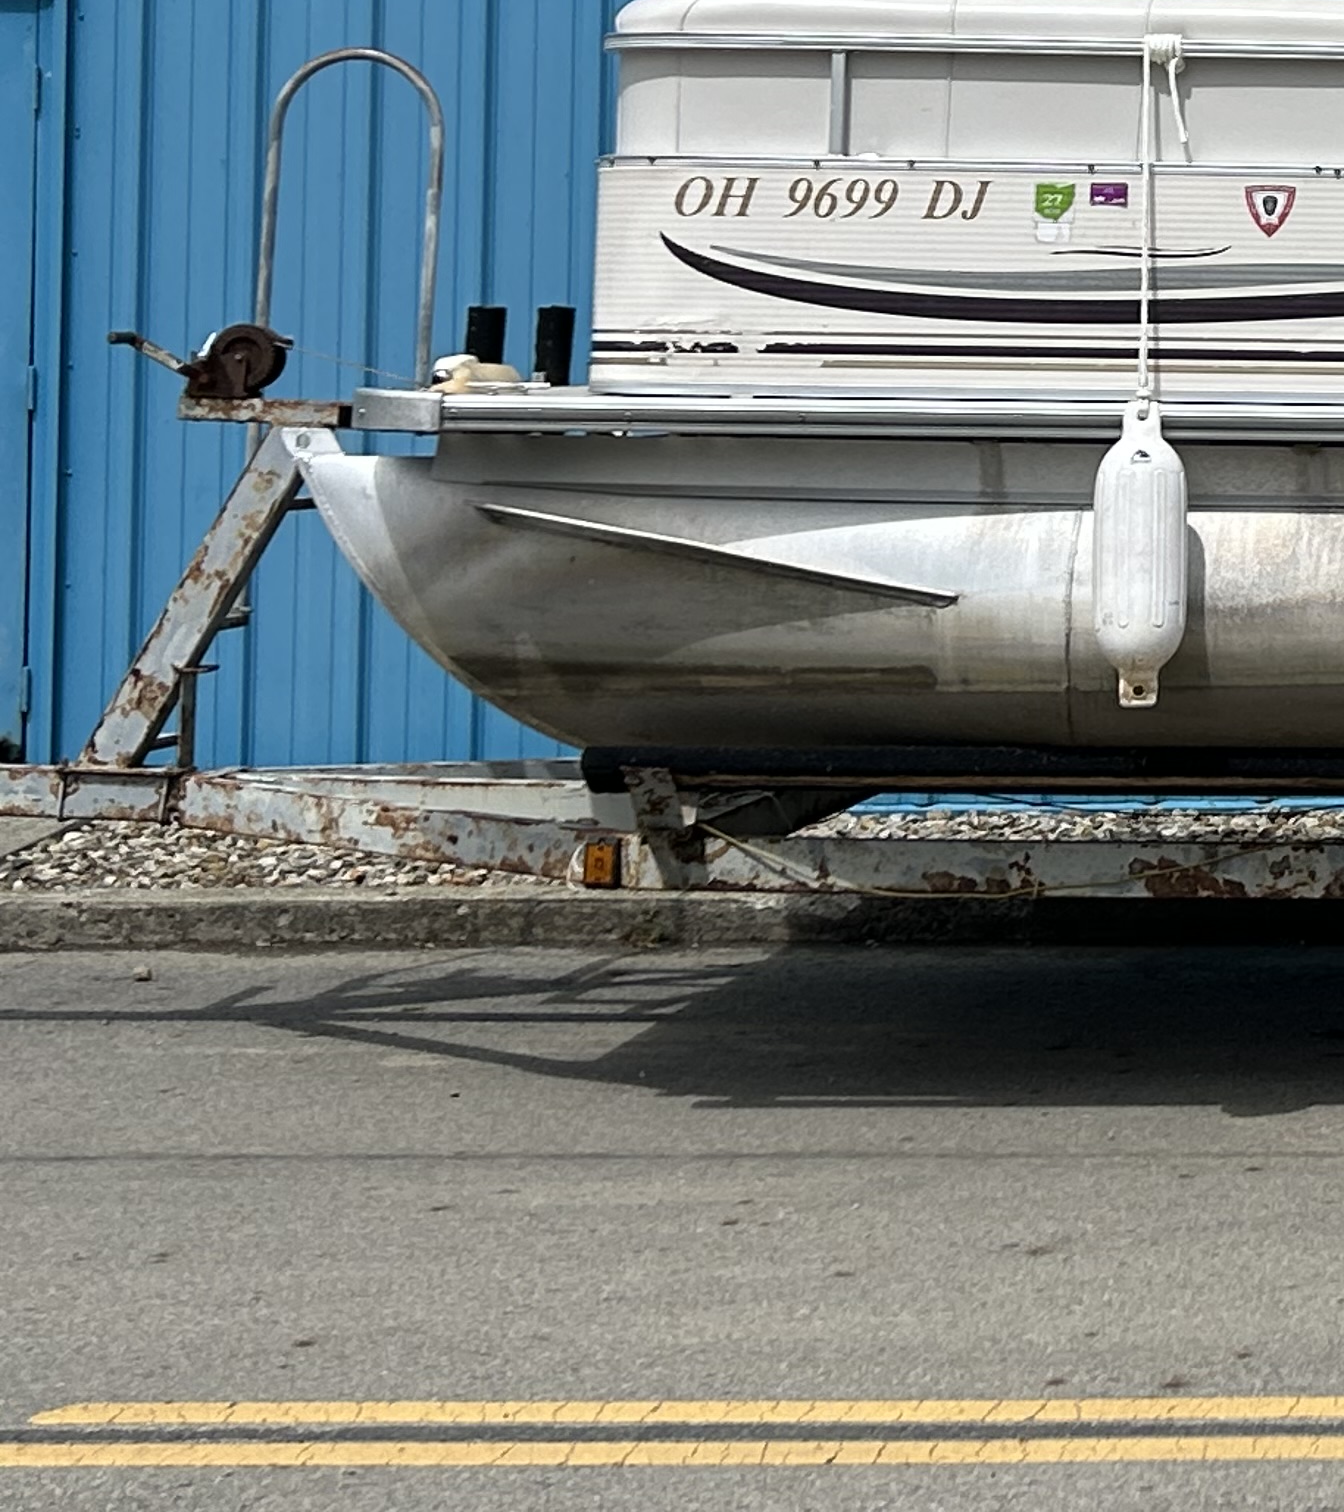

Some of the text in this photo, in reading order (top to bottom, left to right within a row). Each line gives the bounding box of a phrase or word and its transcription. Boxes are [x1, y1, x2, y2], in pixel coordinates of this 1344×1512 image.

[674, 176, 994, 220] OH 9699 DJ
